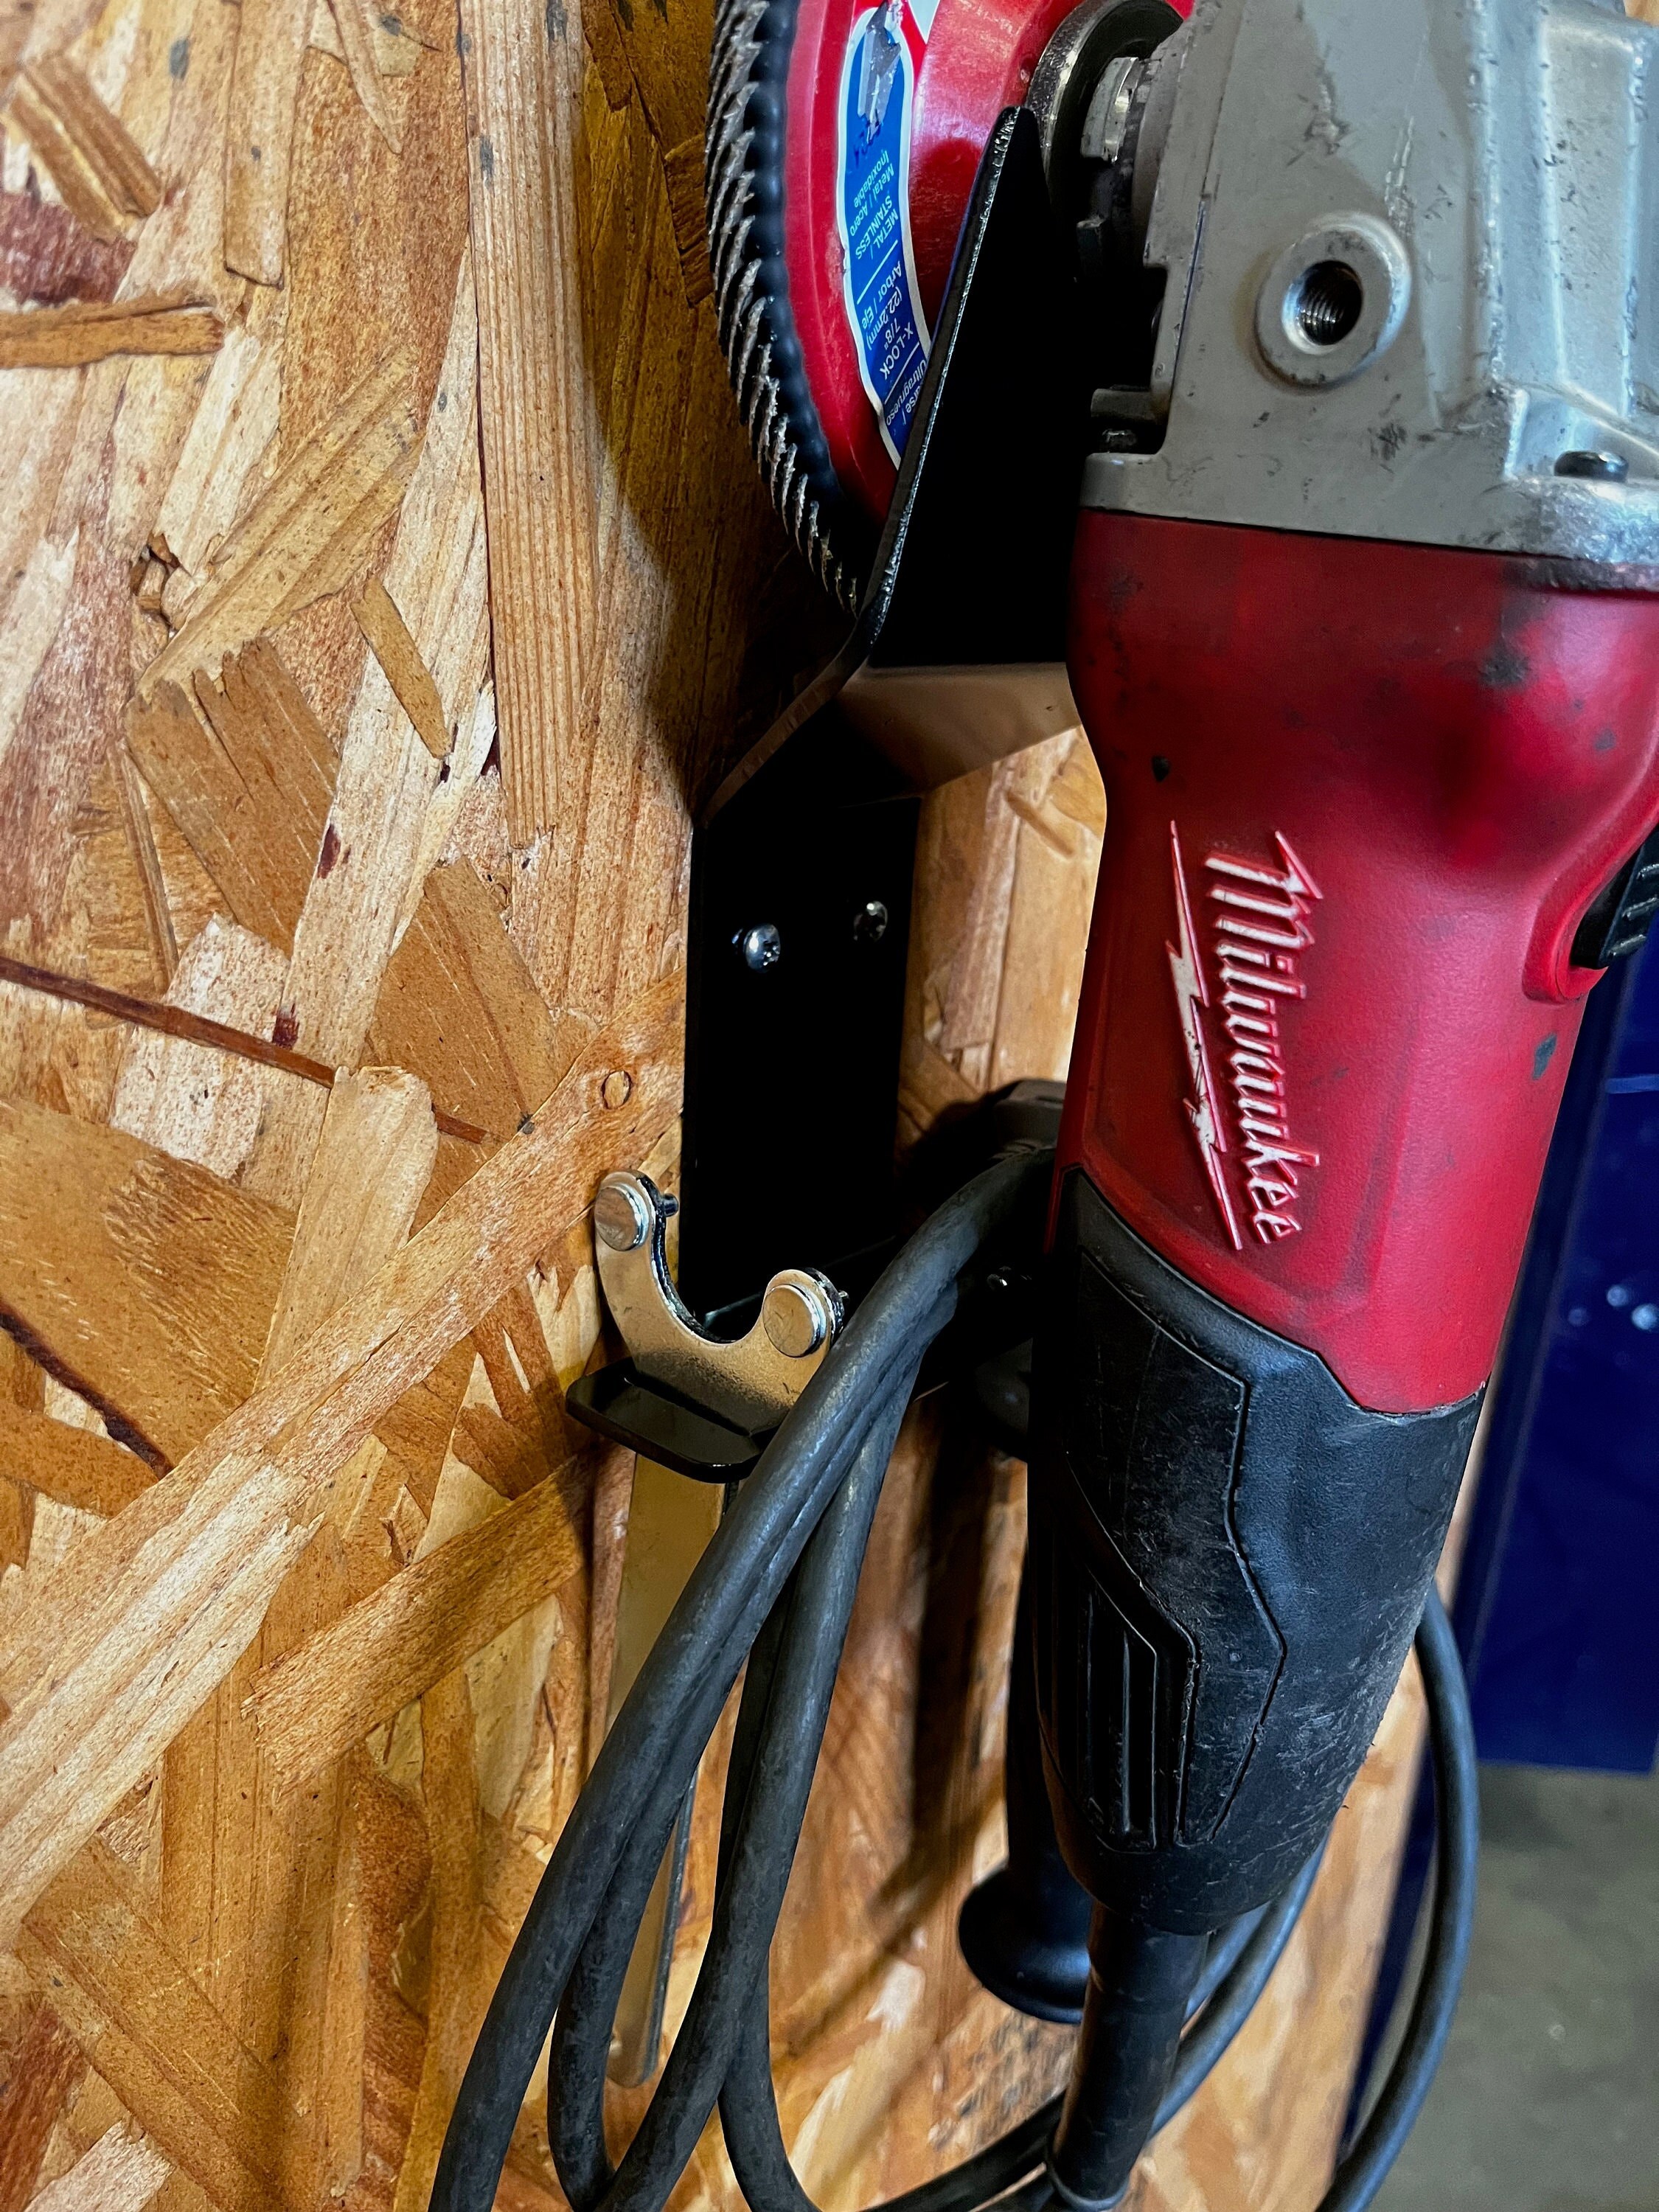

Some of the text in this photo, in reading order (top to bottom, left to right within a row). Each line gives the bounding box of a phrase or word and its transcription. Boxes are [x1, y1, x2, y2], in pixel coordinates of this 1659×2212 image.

[854, 150, 889, 208] Inoxidable
[873, 163, 894, 202] Metal
[849, 200, 868, 237] Acero
[855, 195, 893, 260] STAINLESS
[873, 209, 899, 248] METAL
[877, 260, 902, 303] Arbor
[861, 305, 874, 330] Eje
[866, 286, 902, 351] (22.2mm)
[884, 318, 901, 351] 7/8"
[880, 322, 914, 380] X-LOCK
[1205, 831, 1323, 1245] Milwaukee
